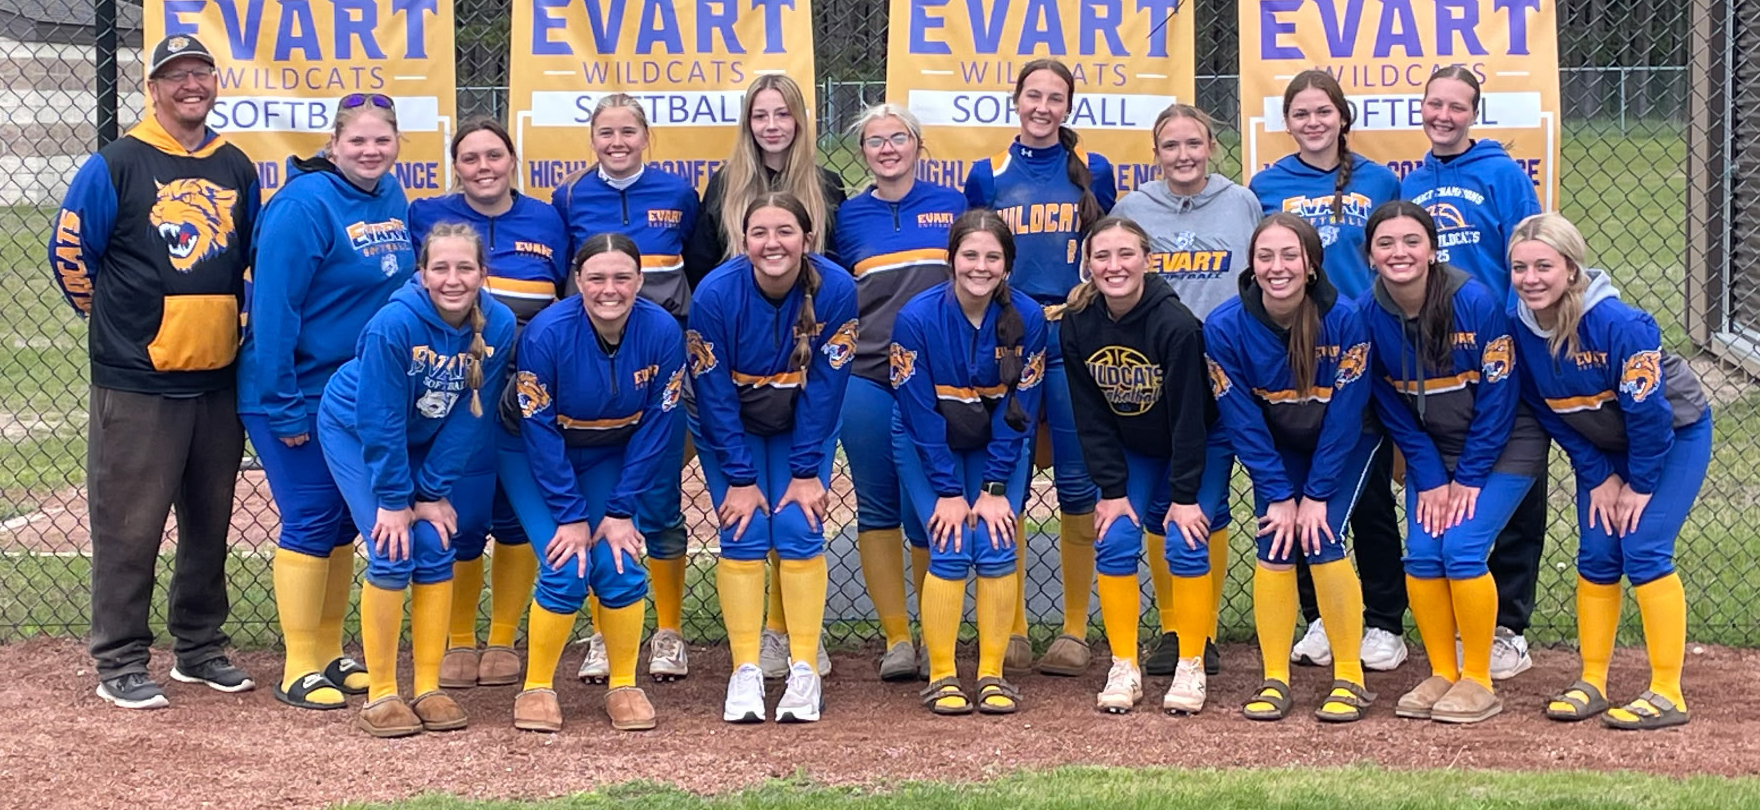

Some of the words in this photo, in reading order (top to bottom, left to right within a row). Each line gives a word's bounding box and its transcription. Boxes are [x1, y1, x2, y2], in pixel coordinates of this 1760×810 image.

[164, 0, 438, 61] EVART
[531, 0, 796, 55] EVART
[909, 0, 1179, 57] EVART
[1260, 0, 1541, 60] EVART
[216, 66, 385, 90] WILDCATS
[583, 60, 745, 85] WILDCATS
[960, 61, 1127, 87] WILATS
[211, 100, 329, 129] SOFTB
[952, 95, 1136, 127] SOFALL
[647, 210, 683, 223] EVART
[917, 212, 954, 224] EVART
[1145, 250, 1228, 273] EVART
